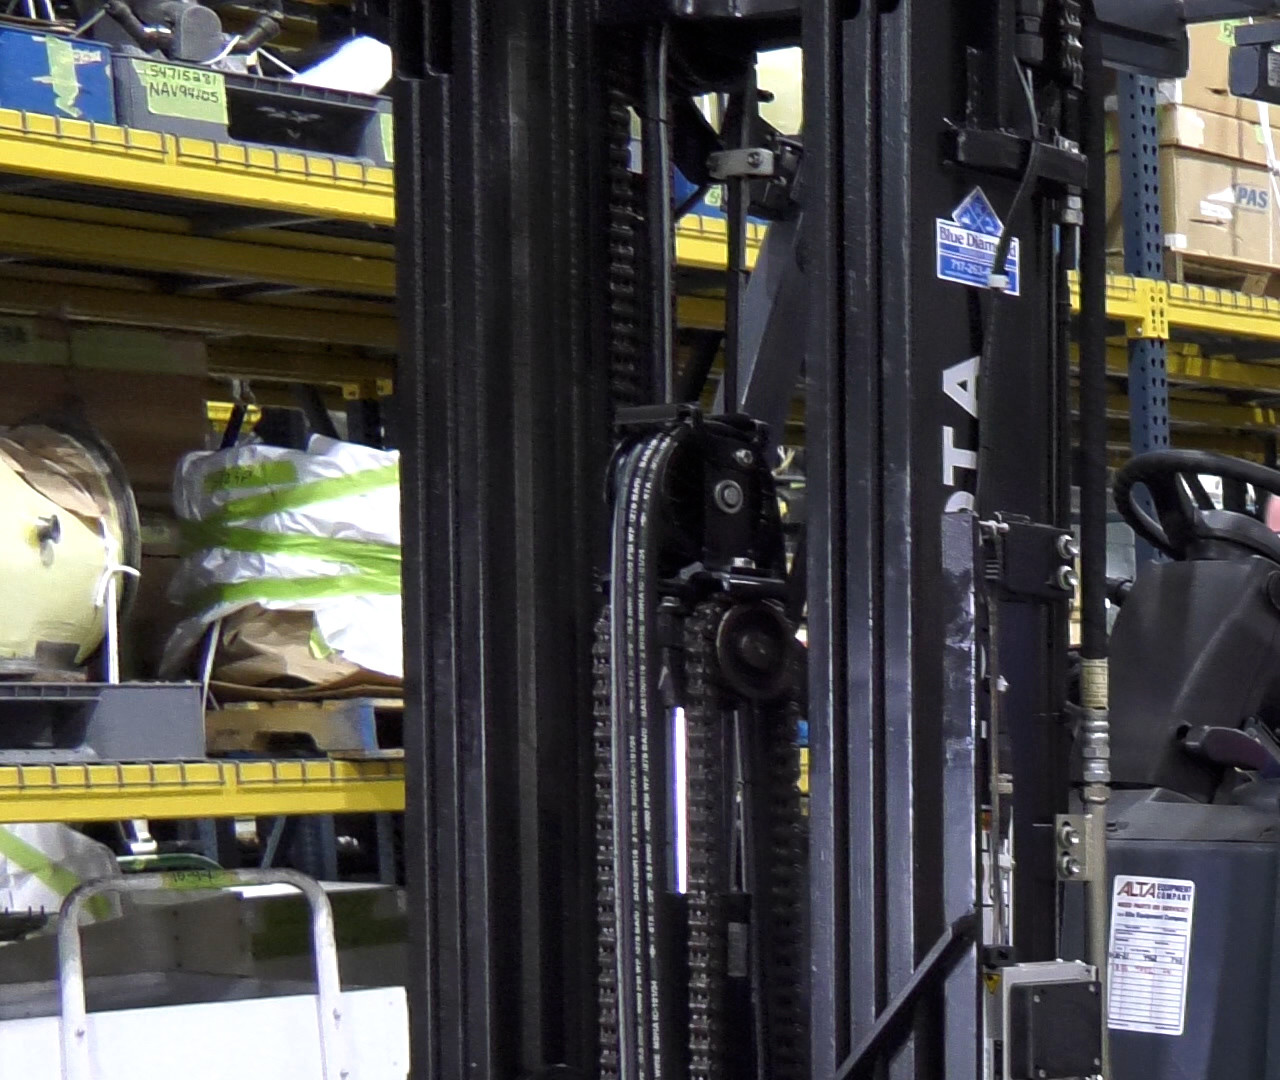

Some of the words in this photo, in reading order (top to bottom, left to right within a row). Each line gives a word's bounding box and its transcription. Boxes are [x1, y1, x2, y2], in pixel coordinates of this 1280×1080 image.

[940, 226, 965, 245] Blue
[966, 232, 1017, 258] Diamd
[1116, 881, 1156, 899] ALTA
